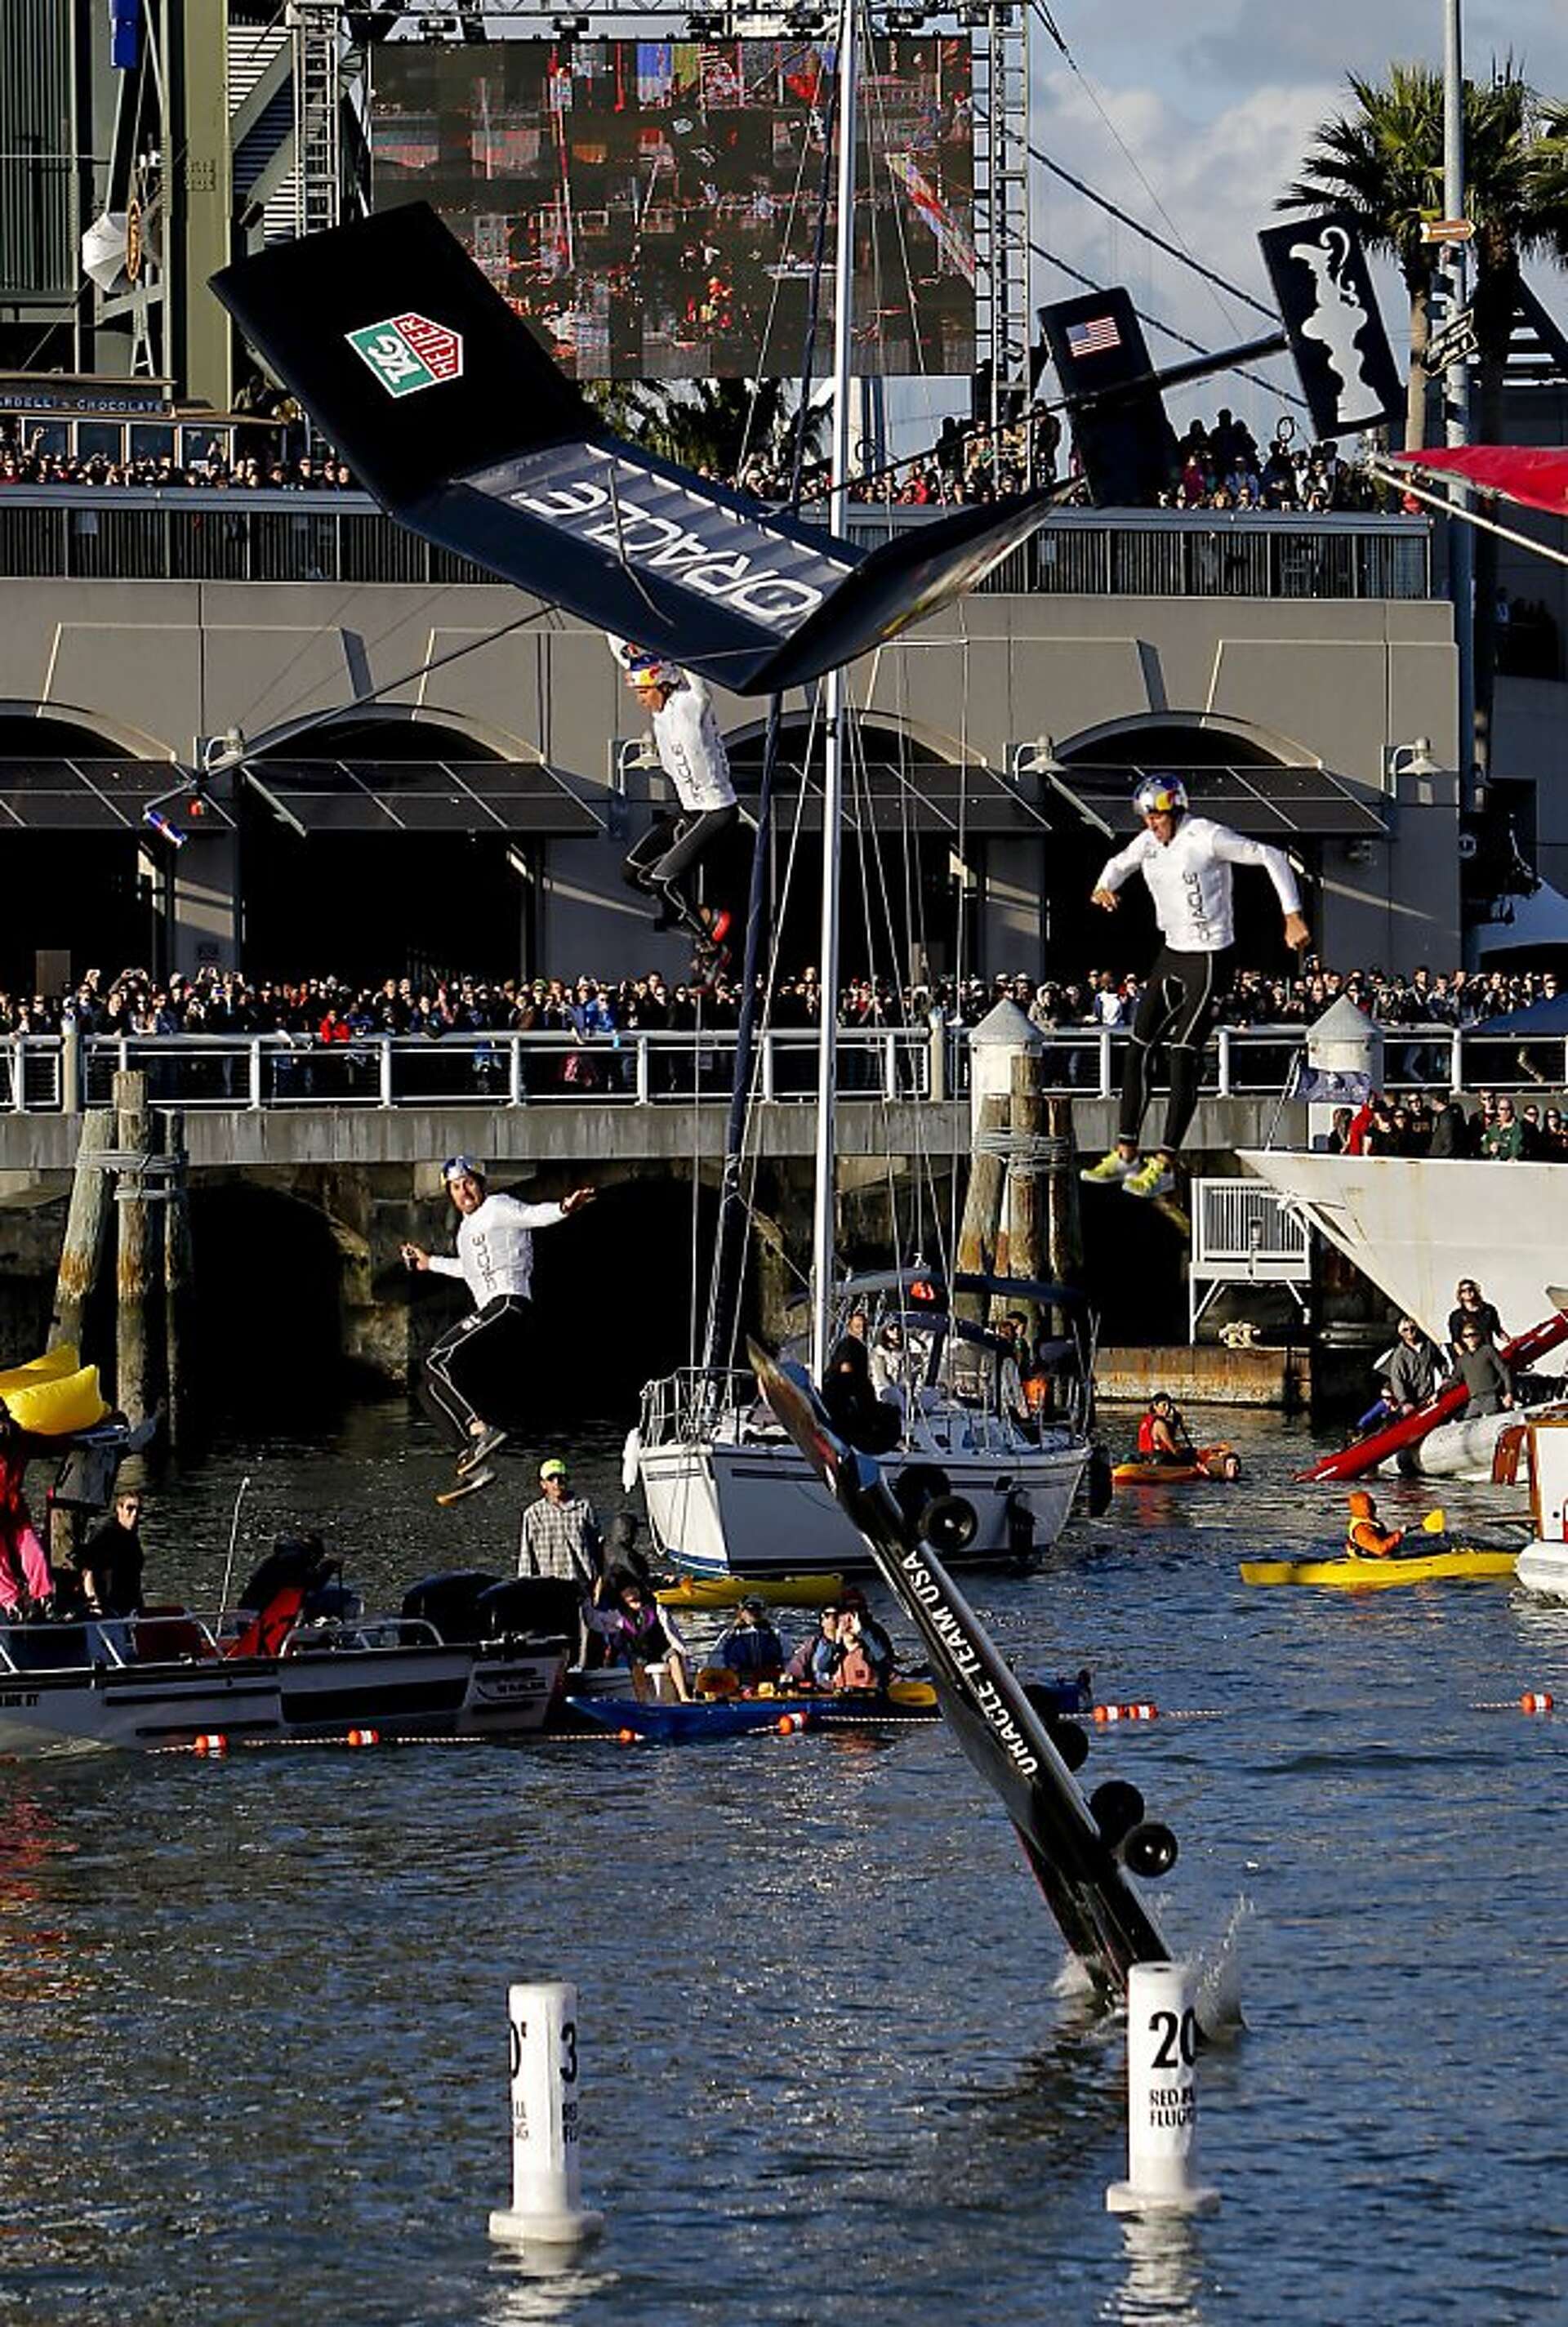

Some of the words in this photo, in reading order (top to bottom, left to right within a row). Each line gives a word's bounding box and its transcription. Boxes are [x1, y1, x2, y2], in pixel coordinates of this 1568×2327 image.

[368, 335, 421, 383] TAG
[399, 317, 455, 377] HEUER
[510, 481, 823, 617] ORACLE
[902, 1550, 940, 1604] USA
[932, 1606, 982, 1677] TEAM
[1149, 2088, 1178, 2107] RED
